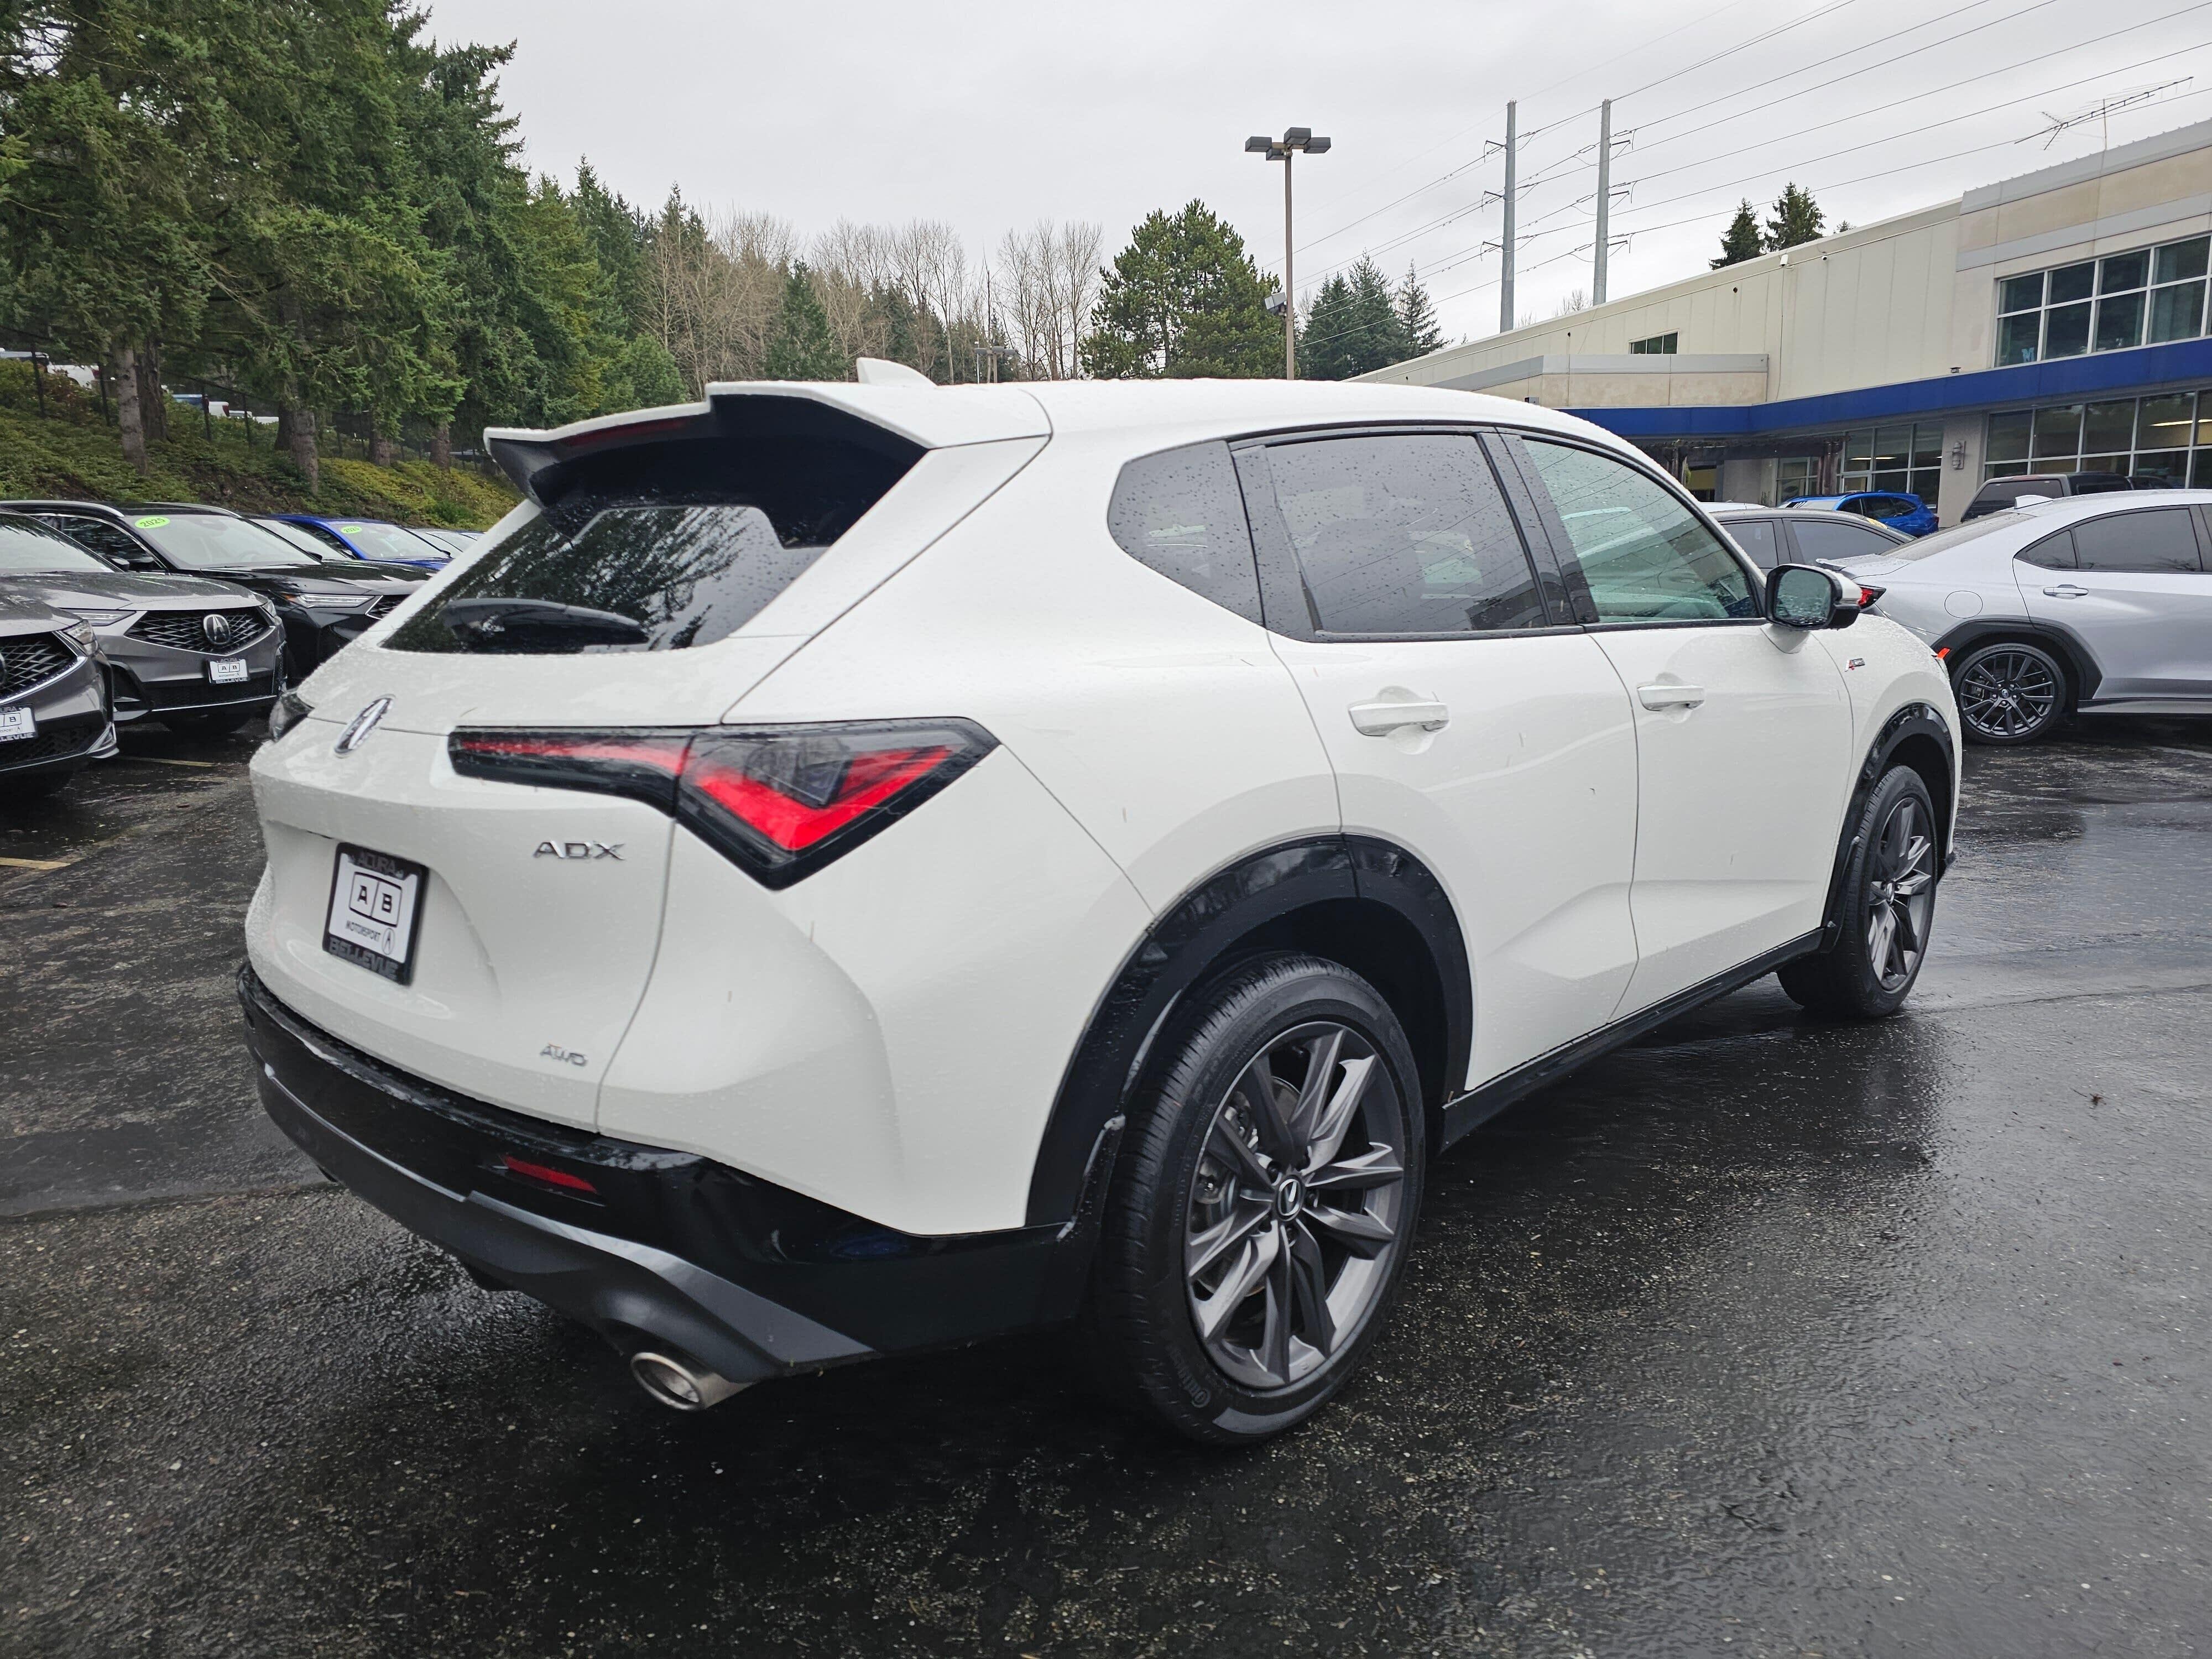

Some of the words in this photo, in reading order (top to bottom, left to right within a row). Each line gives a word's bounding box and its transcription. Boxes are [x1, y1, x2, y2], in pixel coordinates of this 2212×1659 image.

[139, 518, 166, 527] 2025
[533, 839, 626, 861] ADX
[357, 851, 397, 874] ACURA
[357, 885, 368, 905] A
[381, 893, 393, 914] B
[329, 936, 399, 980] BELLEVUE
[540, 1043, 588, 1067] AWD
